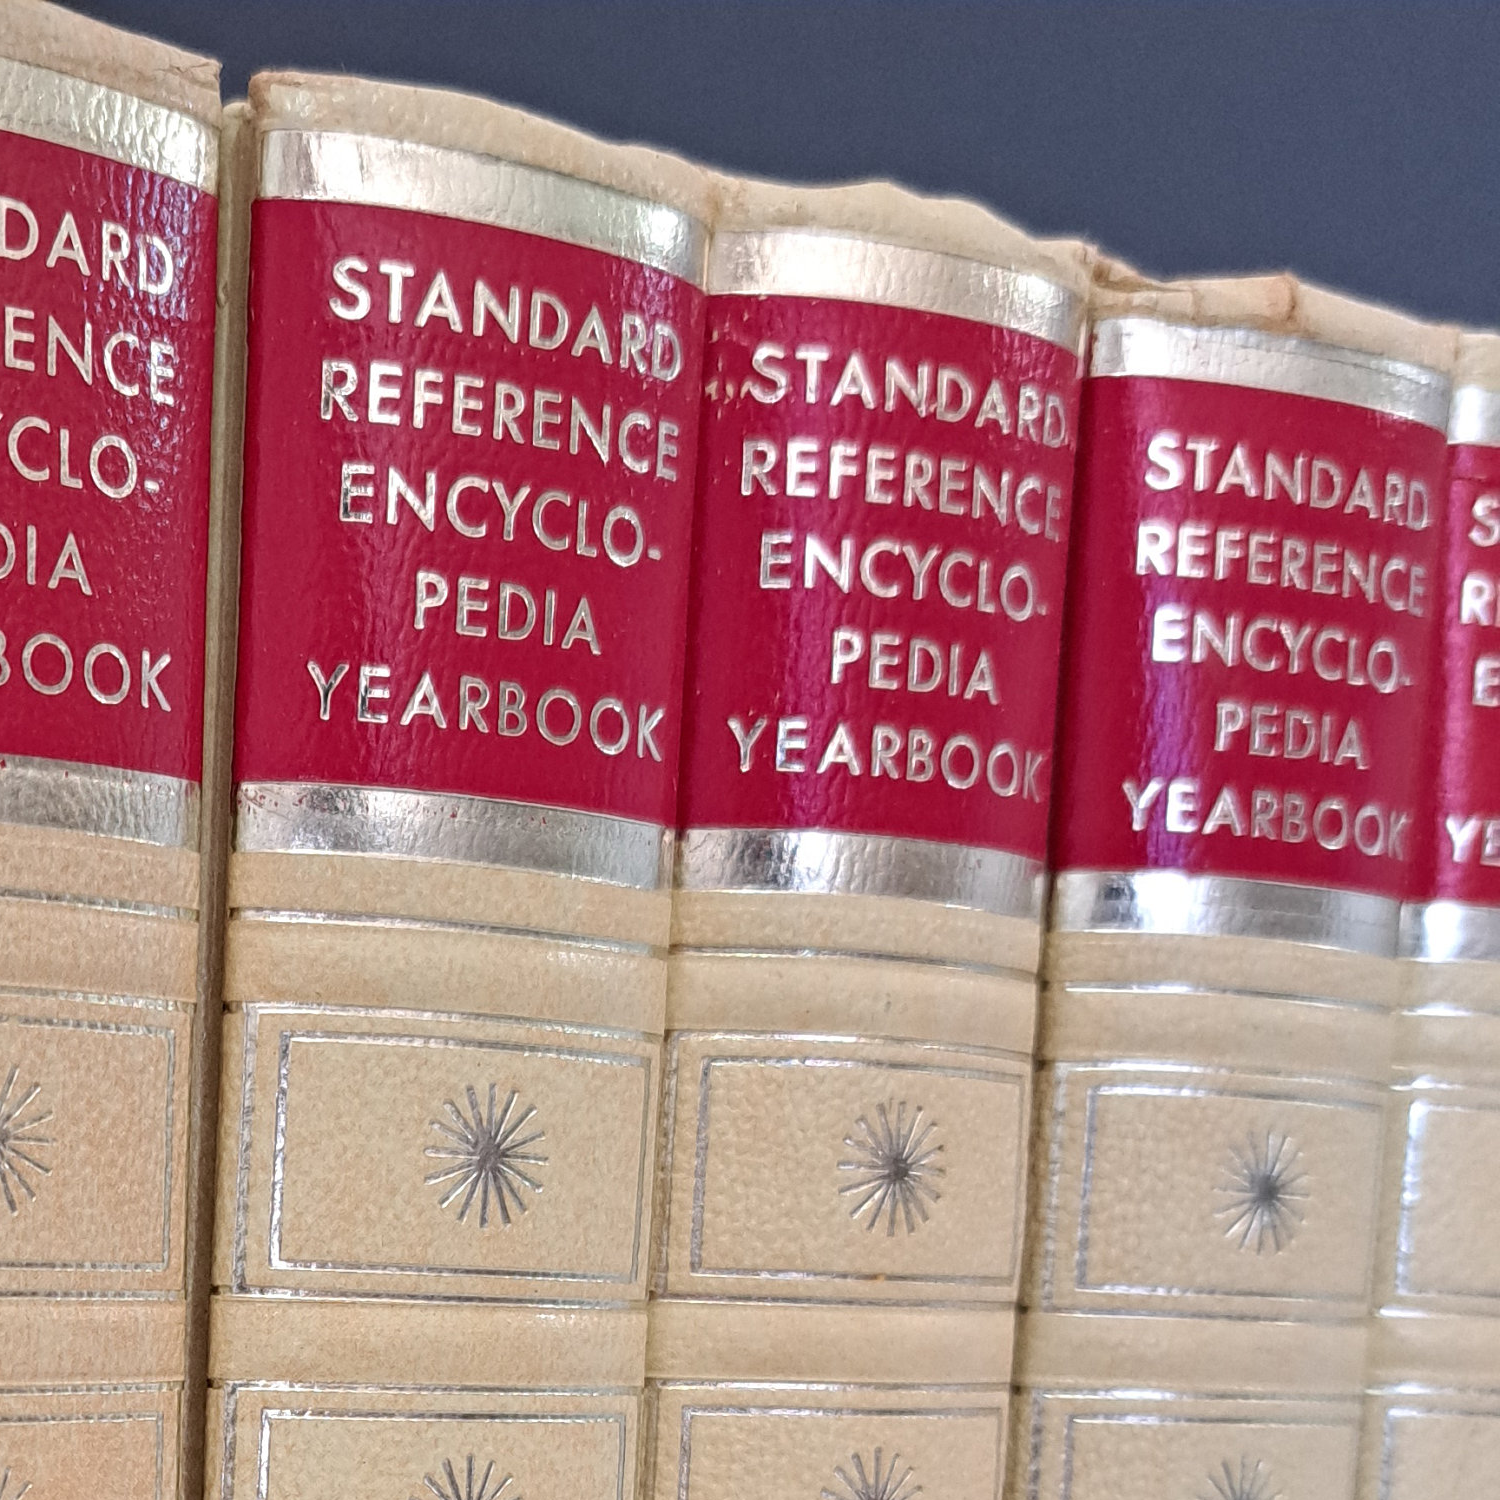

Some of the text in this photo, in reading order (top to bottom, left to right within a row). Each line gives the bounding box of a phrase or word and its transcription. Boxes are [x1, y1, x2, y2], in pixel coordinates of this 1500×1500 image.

[328, 256, 683, 382] STANDARD
[320, 359, 678, 482] REFERENCE
[749, 342, 1069, 449] STANDARD
[741, 437, 1061, 542] REFERENCE
[1144, 429, 1433, 531] STANDARD
[414, 570, 602, 654] PEDIA
[1136, 520, 1426, 618] REFERENCE
[307, 660, 666, 762] YEARBOOK
[830, 627, 999, 706] PEDIA
[727, 716, 1044, 804] YEARBOOK
[1214, 701, 1370, 770] PEDIA
[1122, 777, 1412, 860] YEARBOOK
